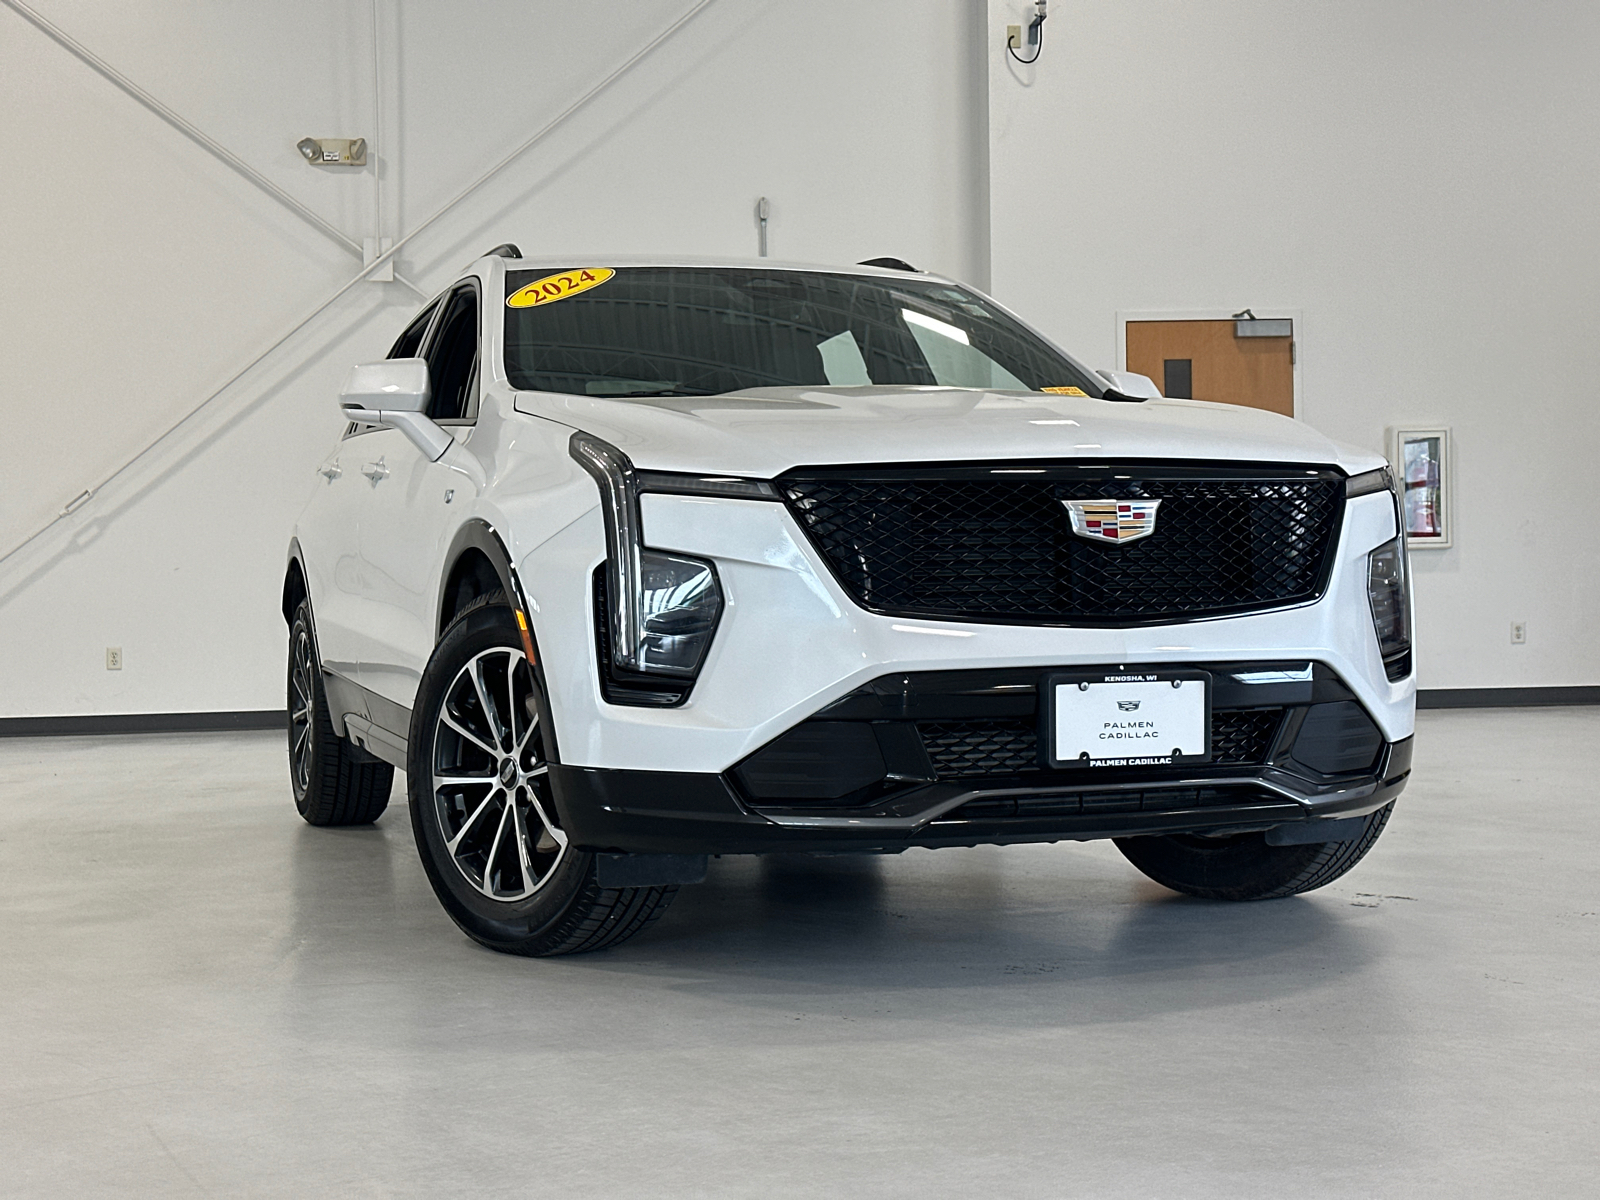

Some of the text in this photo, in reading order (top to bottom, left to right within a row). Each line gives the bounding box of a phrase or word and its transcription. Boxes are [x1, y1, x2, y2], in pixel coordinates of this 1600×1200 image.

[524, 270, 596, 304] 2024
[1103, 721, 1154, 729] PALMEN
[1099, 731, 1159, 740] CADILLAC
[1089, 757, 1172, 767] PALMEN CADILLAC
